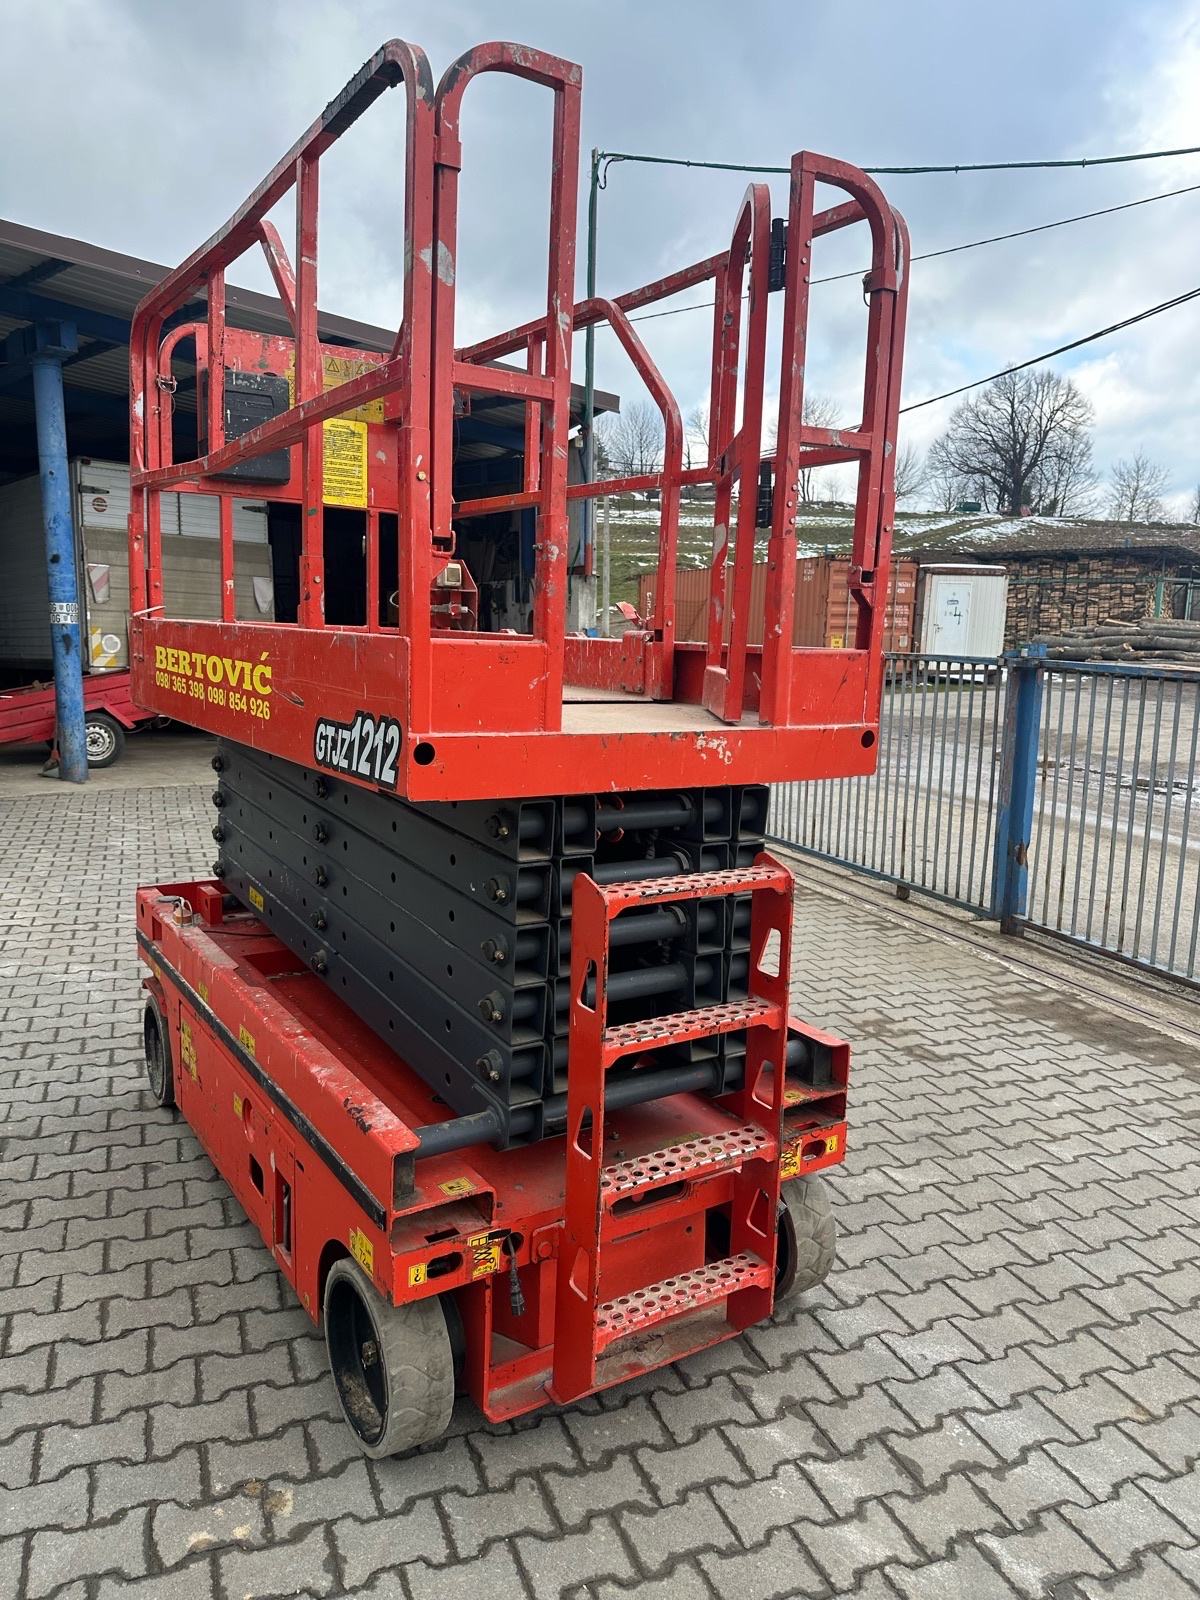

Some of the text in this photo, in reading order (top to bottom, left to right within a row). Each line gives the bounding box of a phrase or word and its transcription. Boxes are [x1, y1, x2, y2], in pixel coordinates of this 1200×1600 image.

[155, 645, 273, 695] BERTOVIĆ
[172, 675, 187, 694] 365
[188, 680, 205, 700] 398
[229, 691, 248, 713] 854
[249, 697, 271, 720] 926
[315, 716, 400, 785] GTJZ1212
